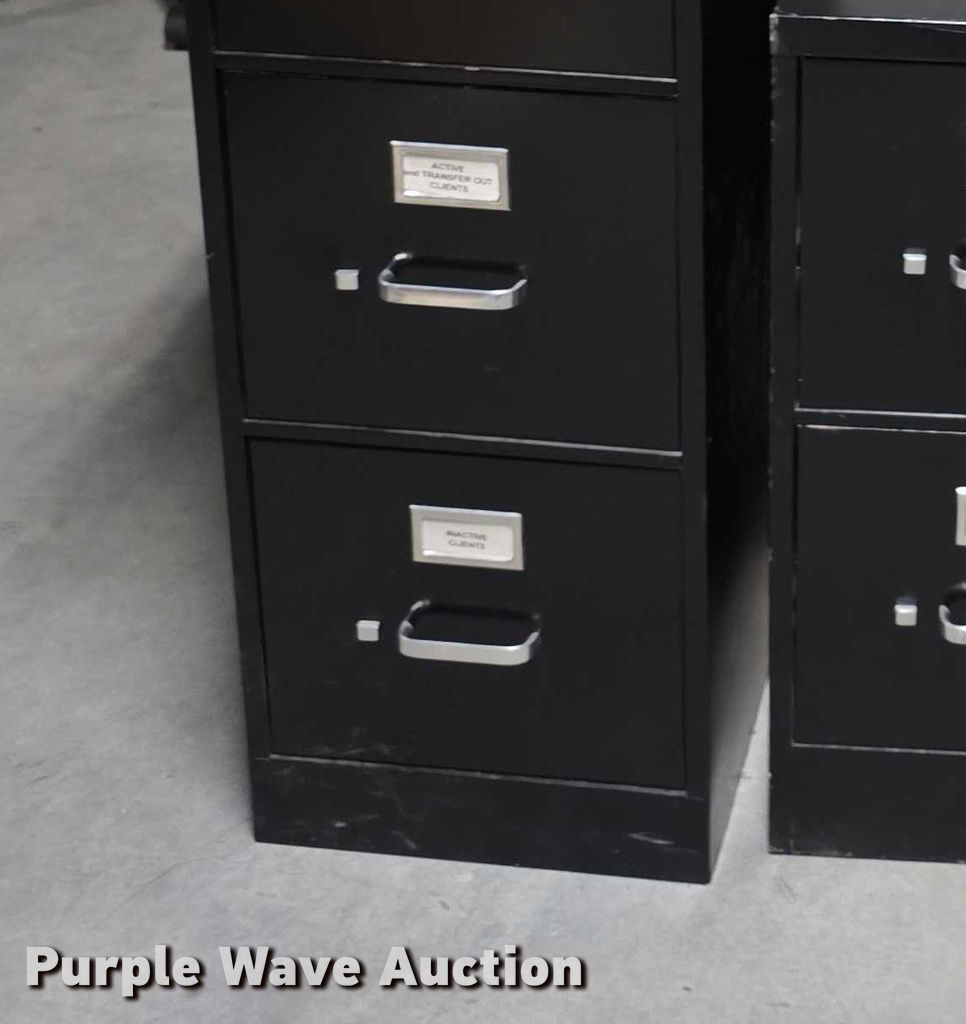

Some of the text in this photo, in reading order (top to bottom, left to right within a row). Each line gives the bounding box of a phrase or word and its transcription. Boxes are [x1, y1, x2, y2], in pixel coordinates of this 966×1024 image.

[431, 162, 464, 173] ACTIVE
[422, 171, 472, 182] TRANSFER
[430, 182, 469, 193] CLIENTS
